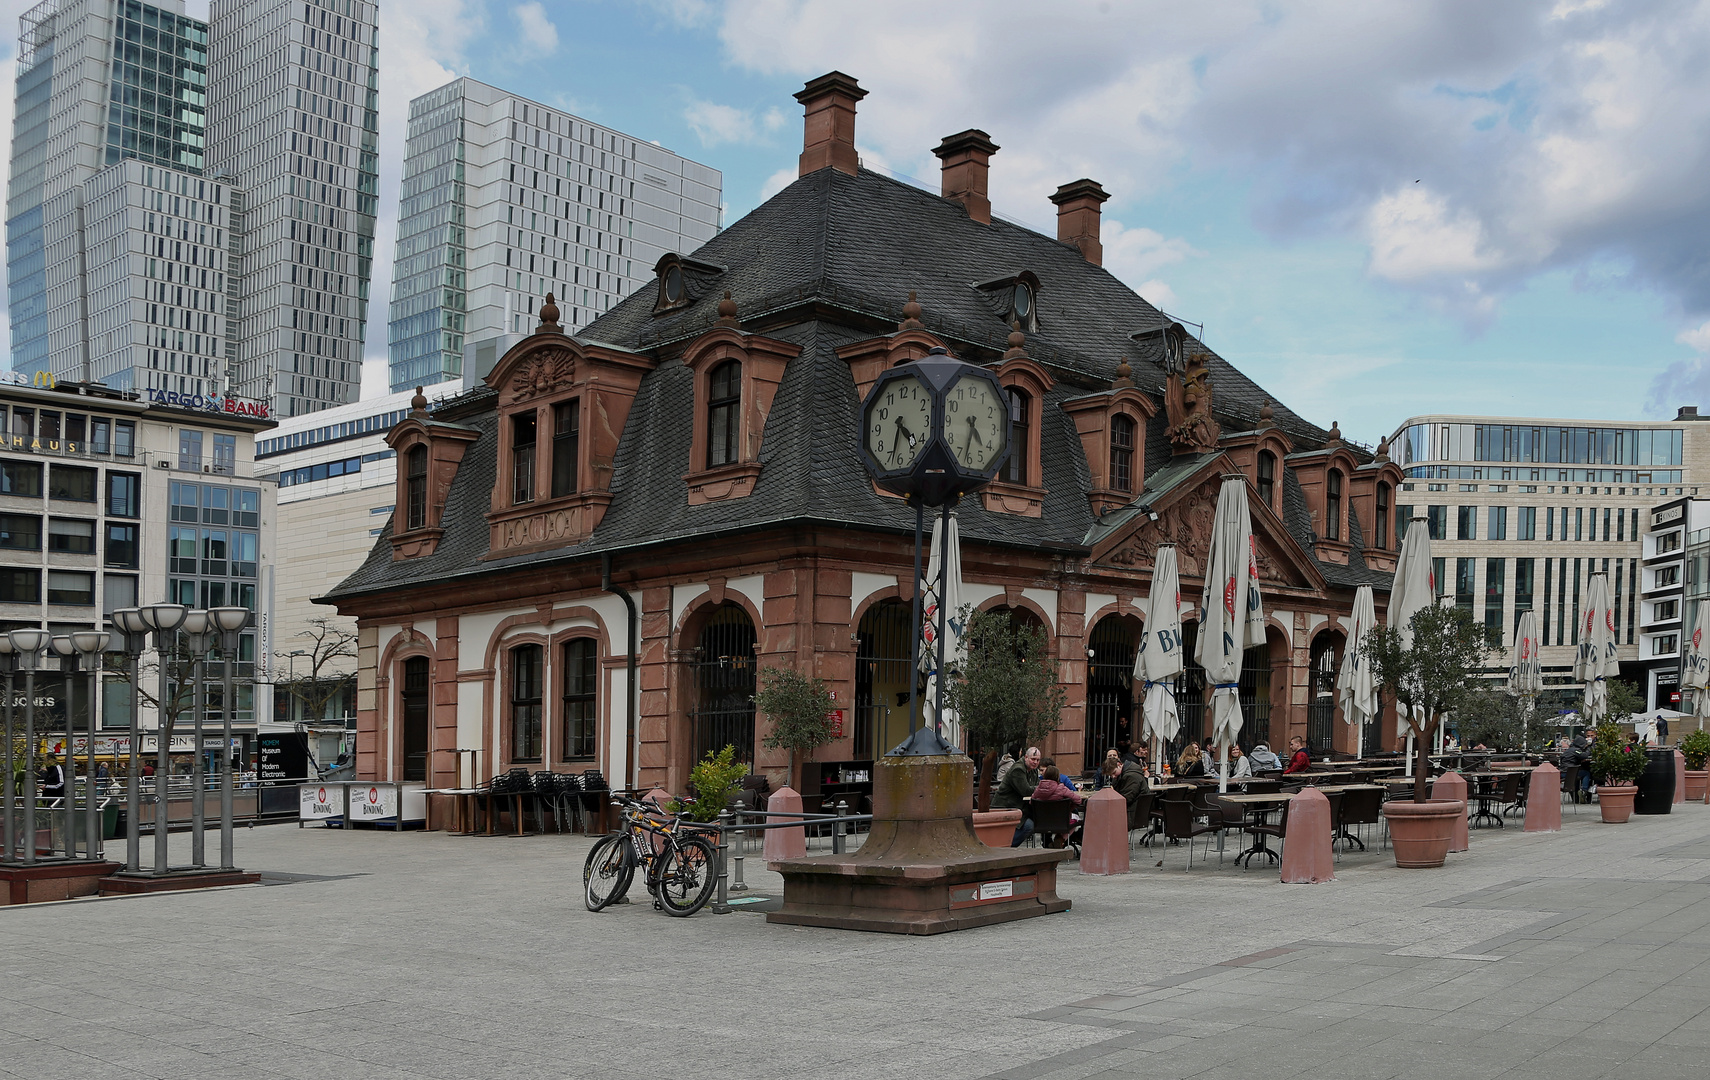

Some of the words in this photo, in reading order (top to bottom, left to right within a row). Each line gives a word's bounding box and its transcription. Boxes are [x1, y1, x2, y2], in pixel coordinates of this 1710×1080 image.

[0, 370, 28, 384] d's
[899, 386, 908, 399] 12
[912, 387, 917, 400] 1
[956, 388, 964, 400] 11
[968, 386, 977, 399] 12
[980, 392, 985, 404] 1
[146, 387, 204, 408] TARGO
[224, 399, 269, 417] BANK
[886, 393, 894, 405] 11
[920, 398, 926, 411] 2
[948, 399, 958, 413] 10
[878, 407, 888, 420] 10
[987, 406, 993, 419] 2
[924, 415, 930, 427] 3
[945, 414, 951, 427] 9
[874, 424, 881, 436] 9
[991, 423, 996, 436] 3
[918, 432, 925, 444] 4
[948, 432, 954, 445] 8
[877, 440, 884, 452] 8
[986, 440, 992, 451] 4
[886, 451, 894, 463] 7
[957, 446, 963, 458] 7
[977, 450, 984, 462] 5
[897, 453, 903, 465] 6
[966, 452, 973, 465] 6
[829, 691, 836, 700] 15
[147, 737, 188, 746] RBIN
[313, 803, 332, 814] BINDING
[363, 803, 384, 815] BINDING
